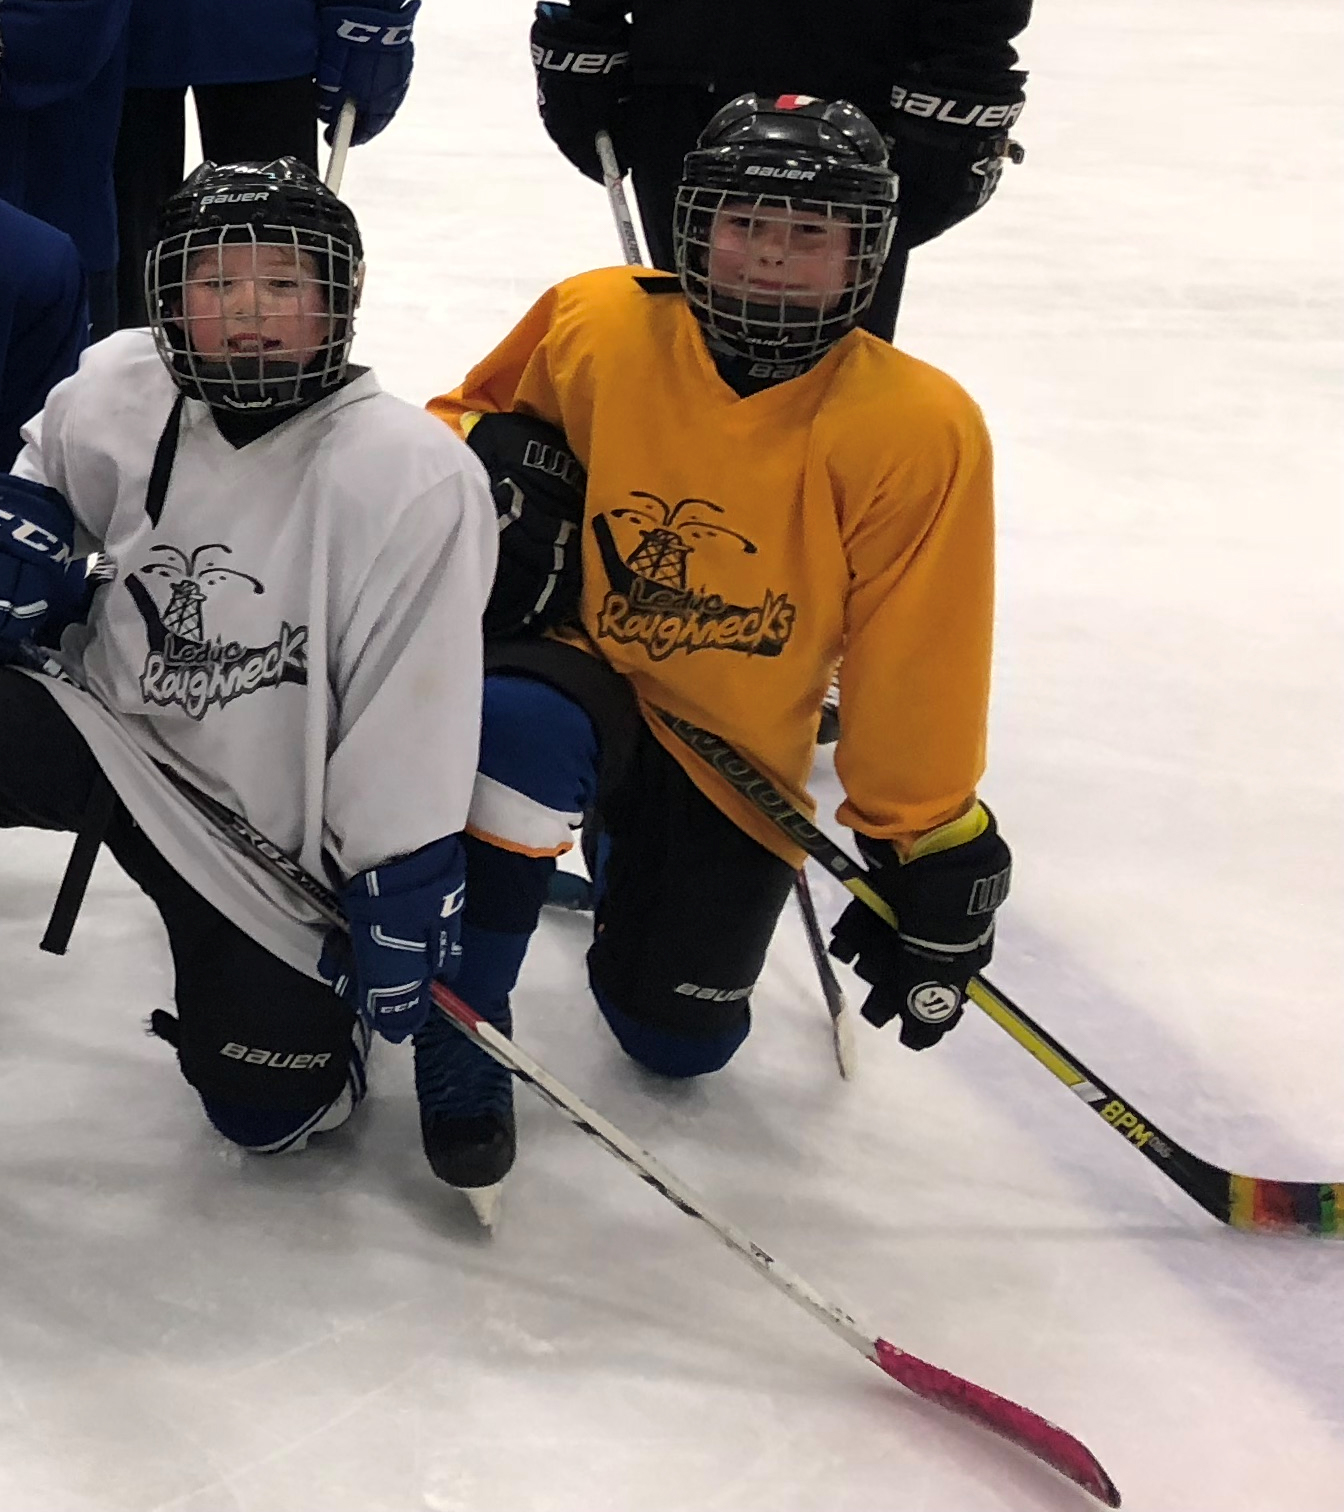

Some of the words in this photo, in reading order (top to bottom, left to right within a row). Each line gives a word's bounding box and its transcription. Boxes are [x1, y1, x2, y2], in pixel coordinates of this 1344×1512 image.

[336, 18, 414, 48] CC
[744, 164, 816, 182] BAUER
[200, 190, 270, 205] BAUER
[597, 588, 797, 662] Roughnecks
[220, 1041, 331, 1070] BAUER
[1098, 1099, 1154, 1150] BPM
